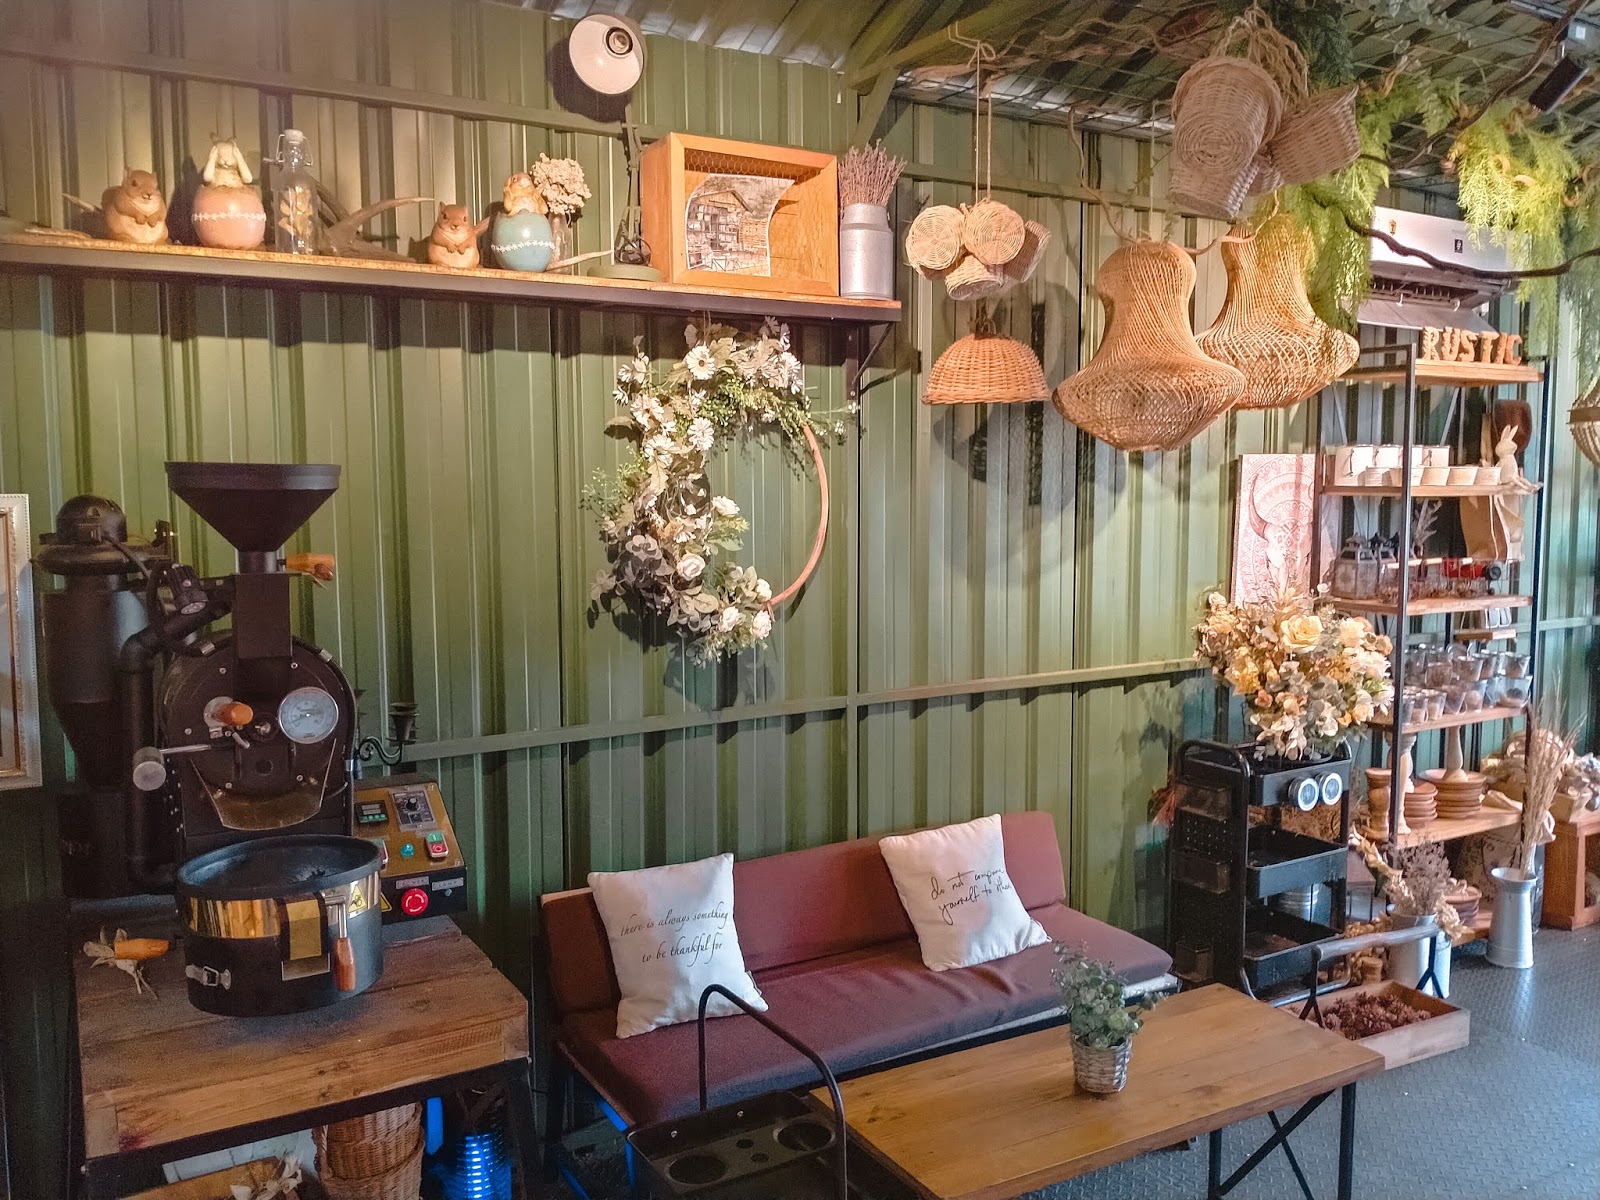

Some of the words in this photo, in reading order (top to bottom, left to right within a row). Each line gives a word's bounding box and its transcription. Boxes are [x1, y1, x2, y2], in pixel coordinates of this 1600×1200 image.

[1421, 325, 1523, 366] RUSTIC
[930, 876, 945, 900] do
[947, 869, 975, 891] not
[620, 913, 644, 936] there
[646, 919, 655, 929] is
[658, 908, 690, 932] always
[692, 901, 729, 930] something
[938, 885, 980, 926] yourself
[981, 885, 992, 897] to
[641, 953, 652, 963] to
[656, 941, 667, 960] be
[670, 932, 712, 968] thankful
[703, 931, 724, 965] for
